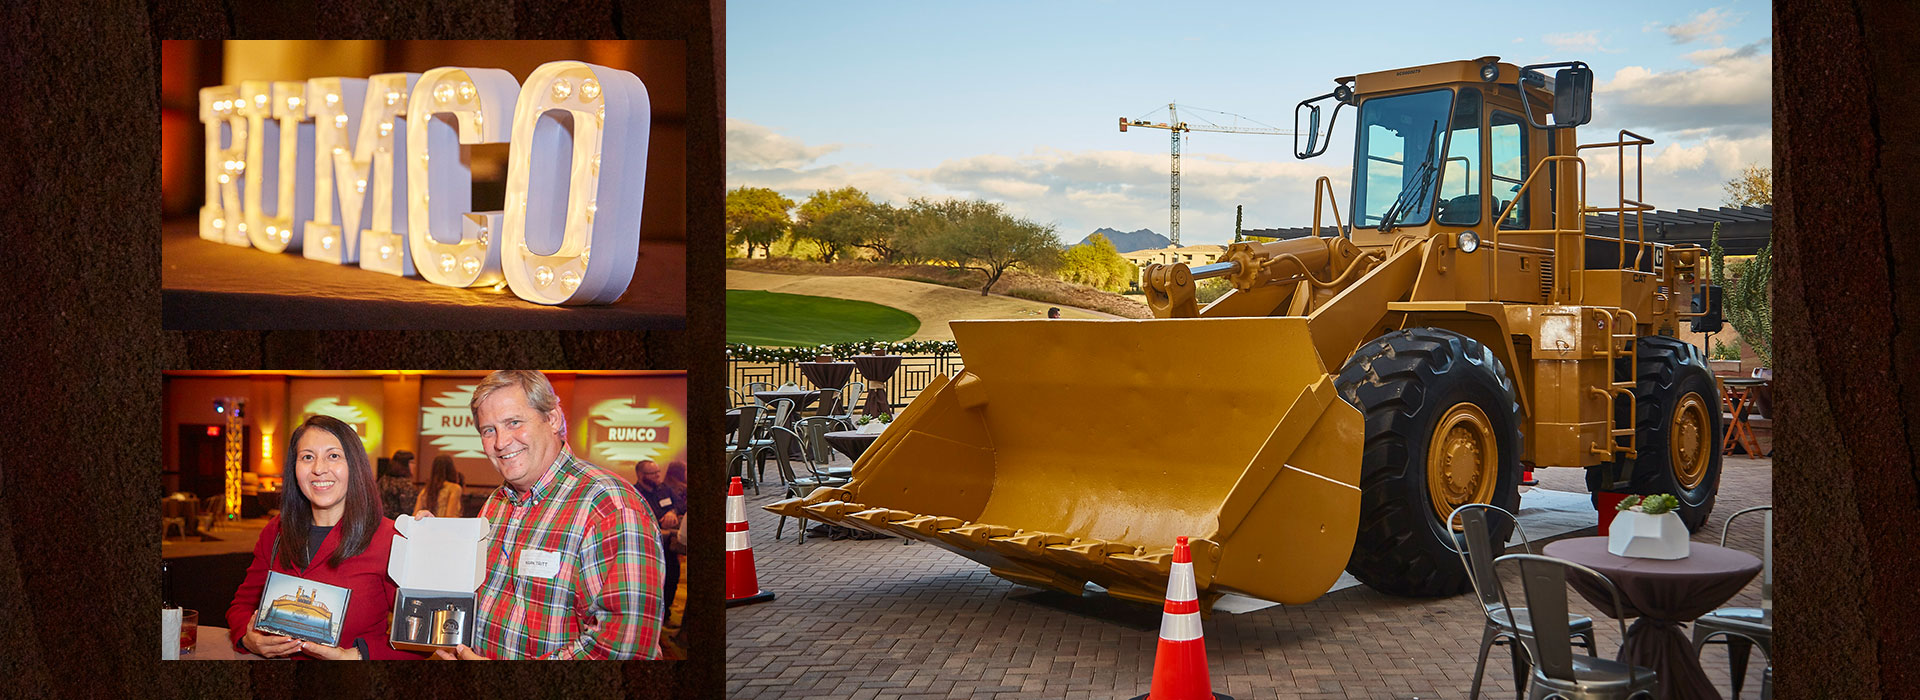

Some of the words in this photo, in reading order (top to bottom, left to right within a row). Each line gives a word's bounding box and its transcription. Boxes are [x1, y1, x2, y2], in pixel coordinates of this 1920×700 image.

[199, 61, 650, 305] RUMCO
[1633, 273, 1647, 283] CAT
[608, 427, 657, 441] RUMCO
